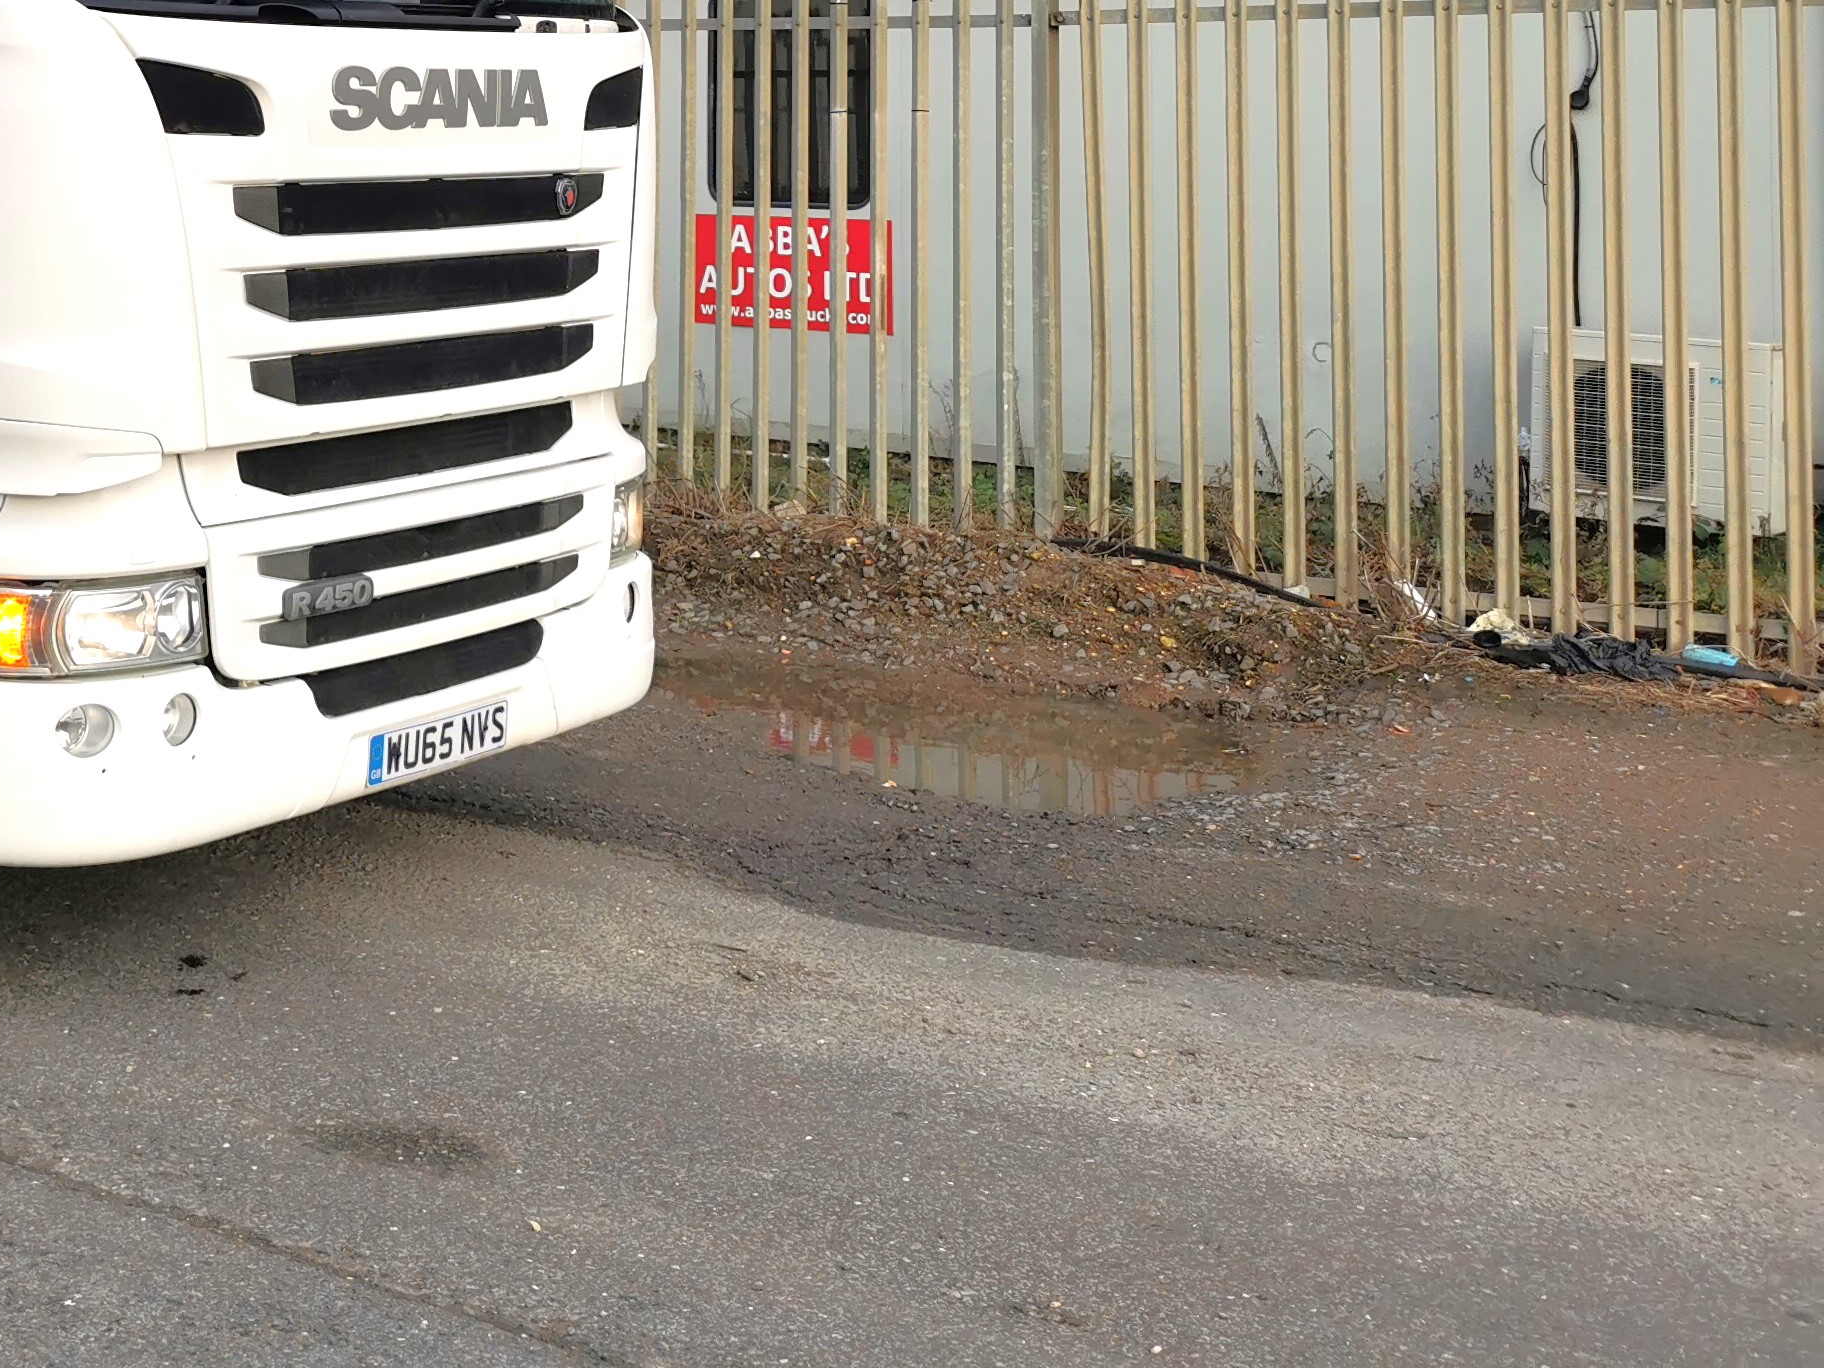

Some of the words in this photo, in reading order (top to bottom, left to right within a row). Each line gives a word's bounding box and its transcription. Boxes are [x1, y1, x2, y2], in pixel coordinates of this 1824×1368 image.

[329, 65, 549, 132] SCANIA
[290, 590, 312, 619] R
[314, 579, 373, 611] 450
[386, 720, 455, 775] WU65
[460, 705, 505, 755] NVS
